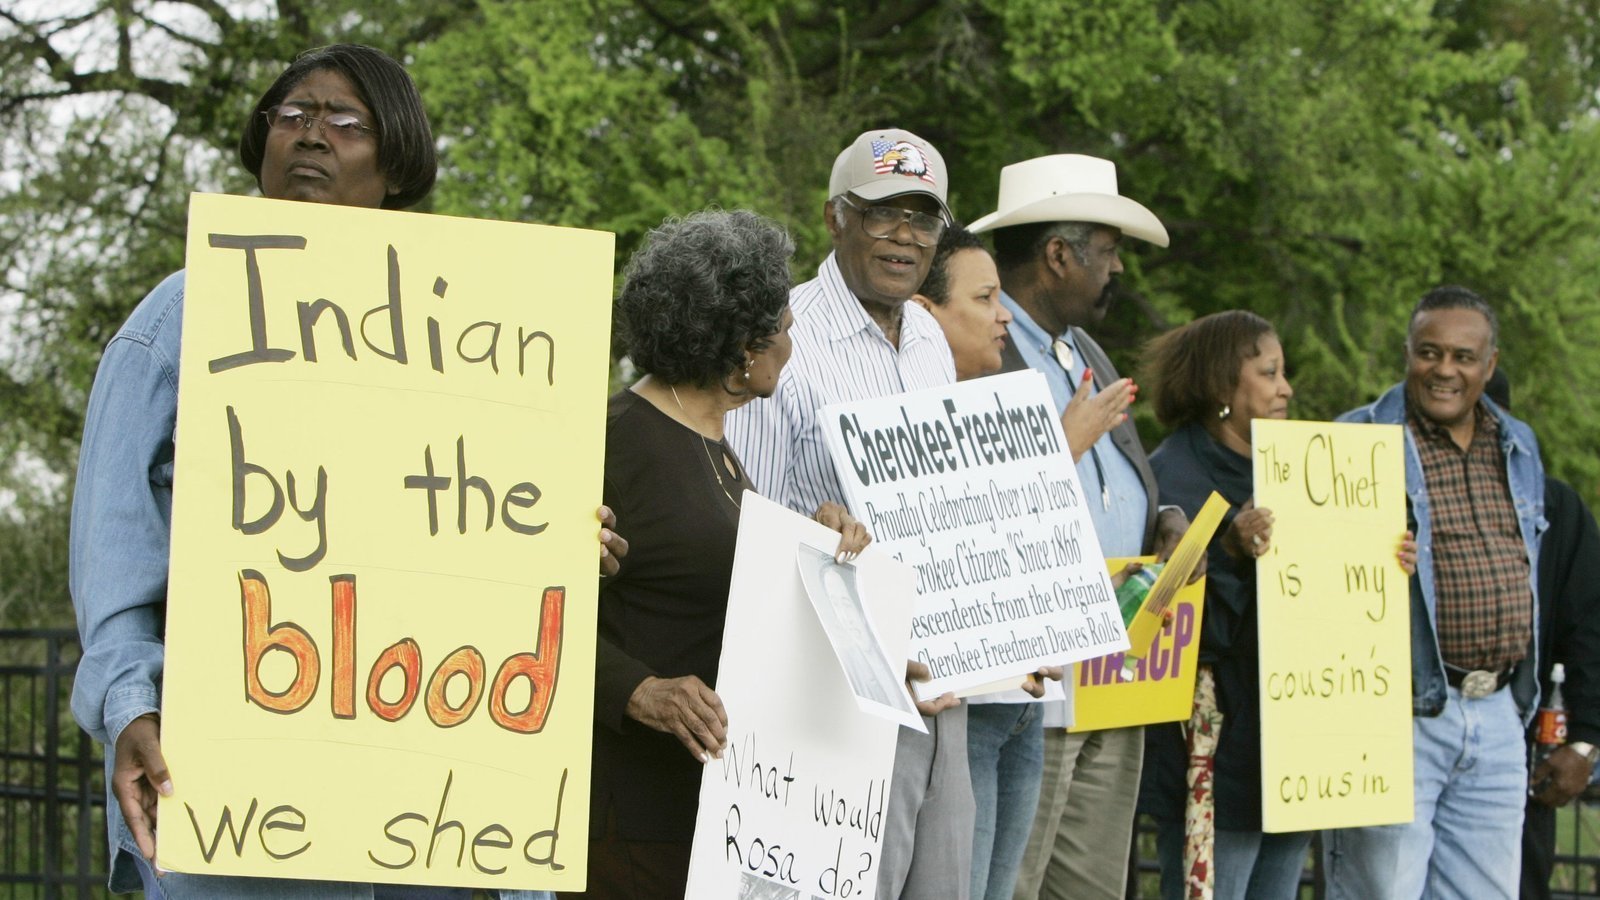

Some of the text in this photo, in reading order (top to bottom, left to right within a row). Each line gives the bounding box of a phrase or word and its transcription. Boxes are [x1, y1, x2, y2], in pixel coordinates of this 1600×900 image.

[208, 233, 555, 386] Indian
[839, 392, 1061, 487] Cherokee Freedmen
[1258, 433, 1386, 509] The Chief
[226, 405, 549, 572] by the
[865, 470, 1079, 547] Proudly Celebrating Over 140 Years
[893, 519, 1083, 596] rokee Citizens "Since 1866"
[1274, 546, 1386, 623] is my
[910, 598, 993, 640] escendents
[990, 591, 1030, 623] from
[1028, 584, 1053, 612] the
[1053, 571, 1111, 615] Original
[980, 630, 1047, 669] Freedmen
[1045, 625, 1090, 656] Dawes
[1086, 611, 1121, 646] Rolls
[239, 568, 566, 734] blood
[1267, 644, 1390, 701] cousin's
[722, 731, 795, 808] What
[1280, 753, 1390, 803] cousin
[368, 768, 568, 875] shed
[725, 803, 872, 898] Rosa do?
